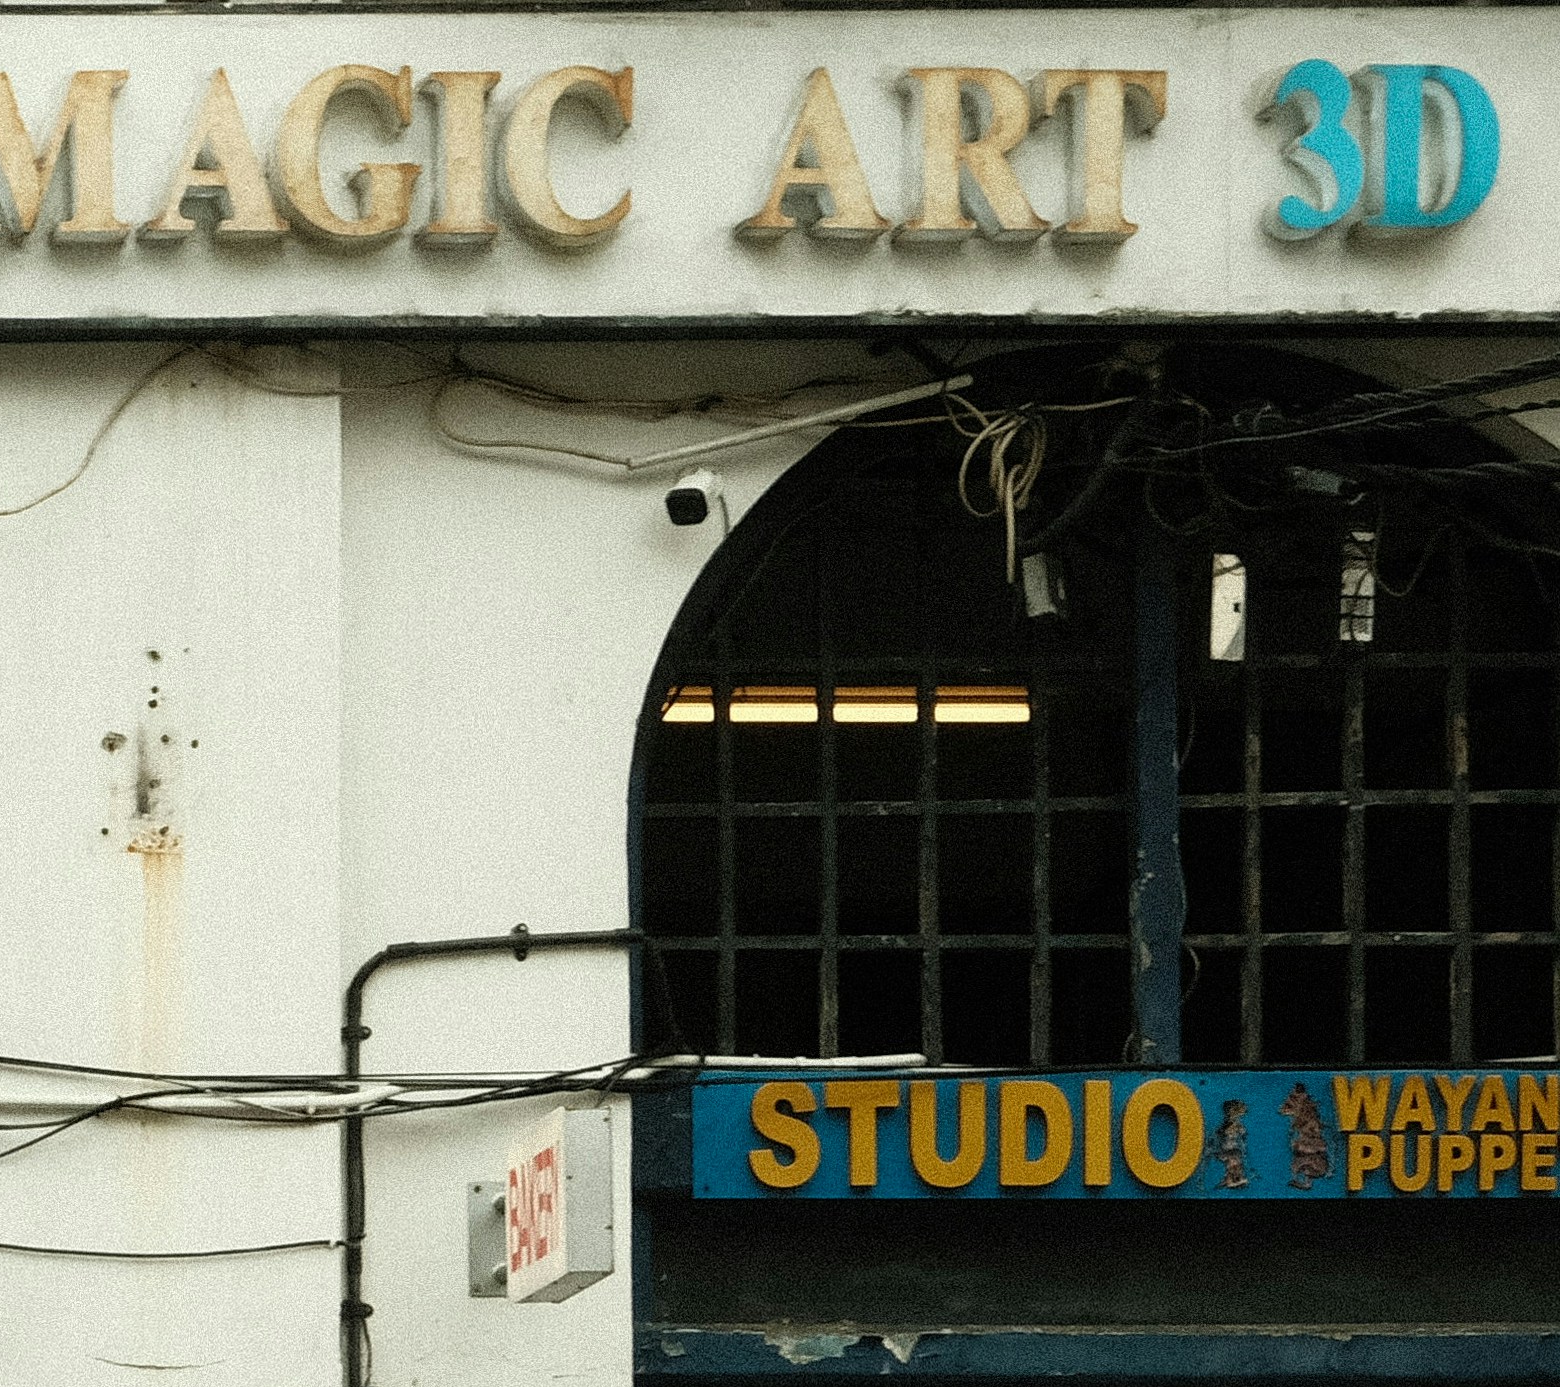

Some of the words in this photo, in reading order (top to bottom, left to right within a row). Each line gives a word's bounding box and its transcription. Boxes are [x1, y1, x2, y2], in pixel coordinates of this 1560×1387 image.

[730, 65, 1168, 249] ART
[1255, 57, 1502, 243] 3D
[747, 1078, 1205, 1189] STUDIO
